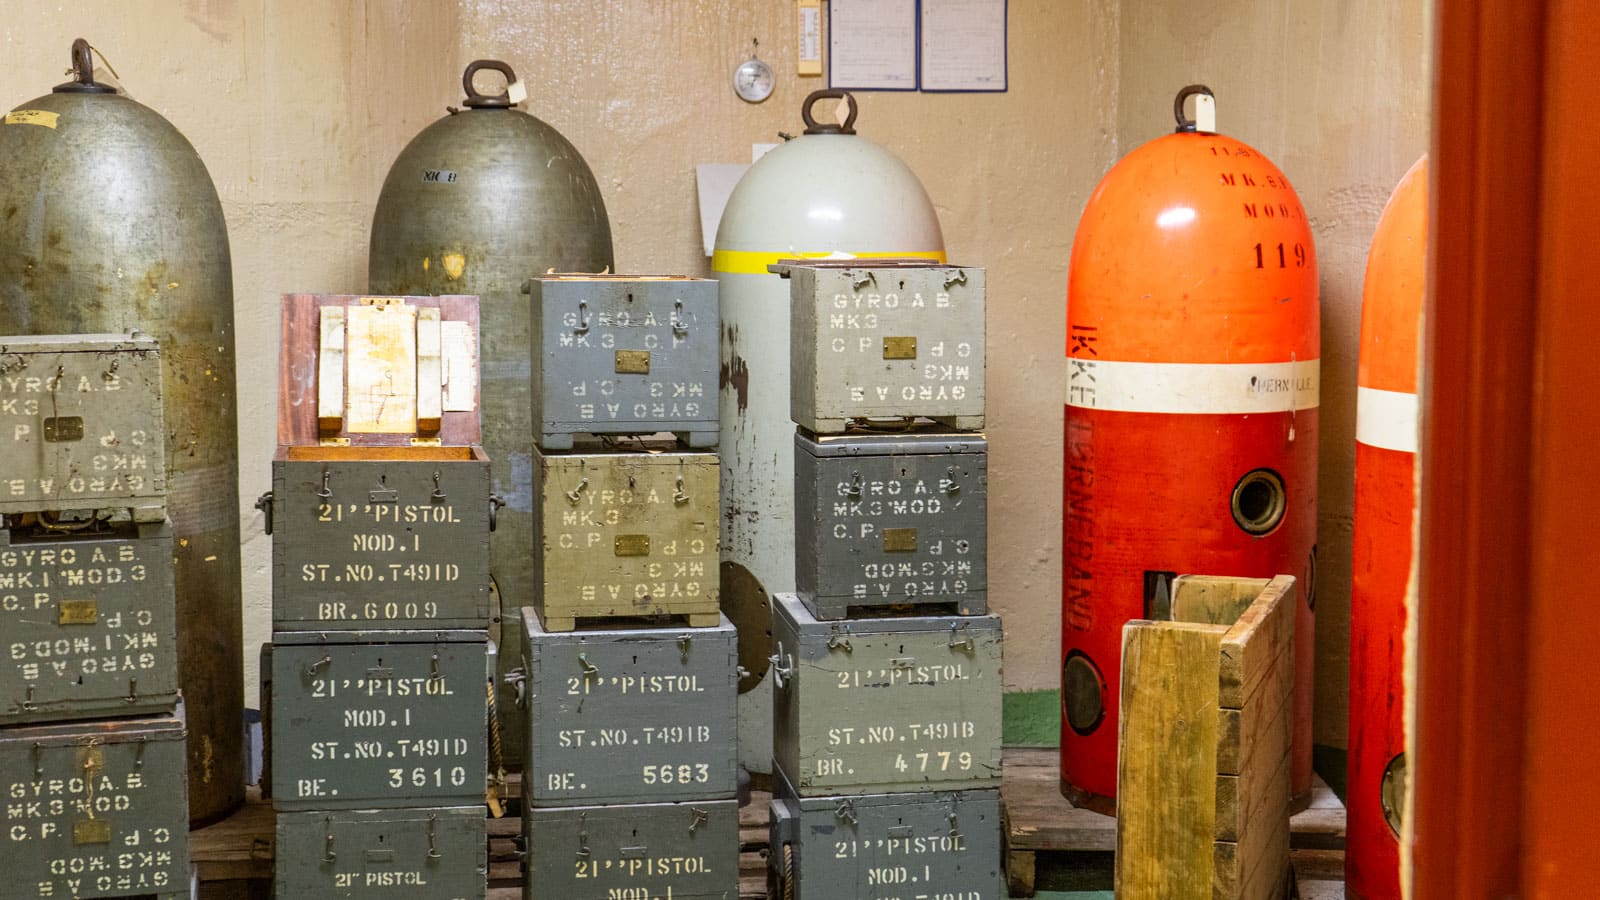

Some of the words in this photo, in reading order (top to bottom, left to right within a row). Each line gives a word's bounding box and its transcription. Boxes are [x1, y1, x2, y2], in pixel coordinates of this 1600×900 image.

[1254, 243, 1305, 268] 119
[834, 293, 898, 309] GYRO
[1071, 325, 1097, 407] IKKE
[0, 375, 61, 393] YRO
[902, 386, 966, 401] GYRO
[634, 402, 700, 418] GYRO
[69, 475, 144, 493] GYRO
[837, 480, 902, 497] GYRO
[1, 548, 76, 568] GYRO
[635, 582, 700, 599] GYRO
[904, 580, 968, 597] GYRO
[81, 653, 155, 675] GYRO
[817, 758, 854, 776] BR.
[895, 752, 972, 773] 4779
[298, 778, 339, 797] BE.
[388, 766, 466, 788] 3610
[548, 773, 587, 790] BE.
[643, 763, 709, 784] 5683
[10, 777, 85, 798] GYRO
[97, 871, 169, 893] GYRO
[366, 871, 428, 886] PISTOL
